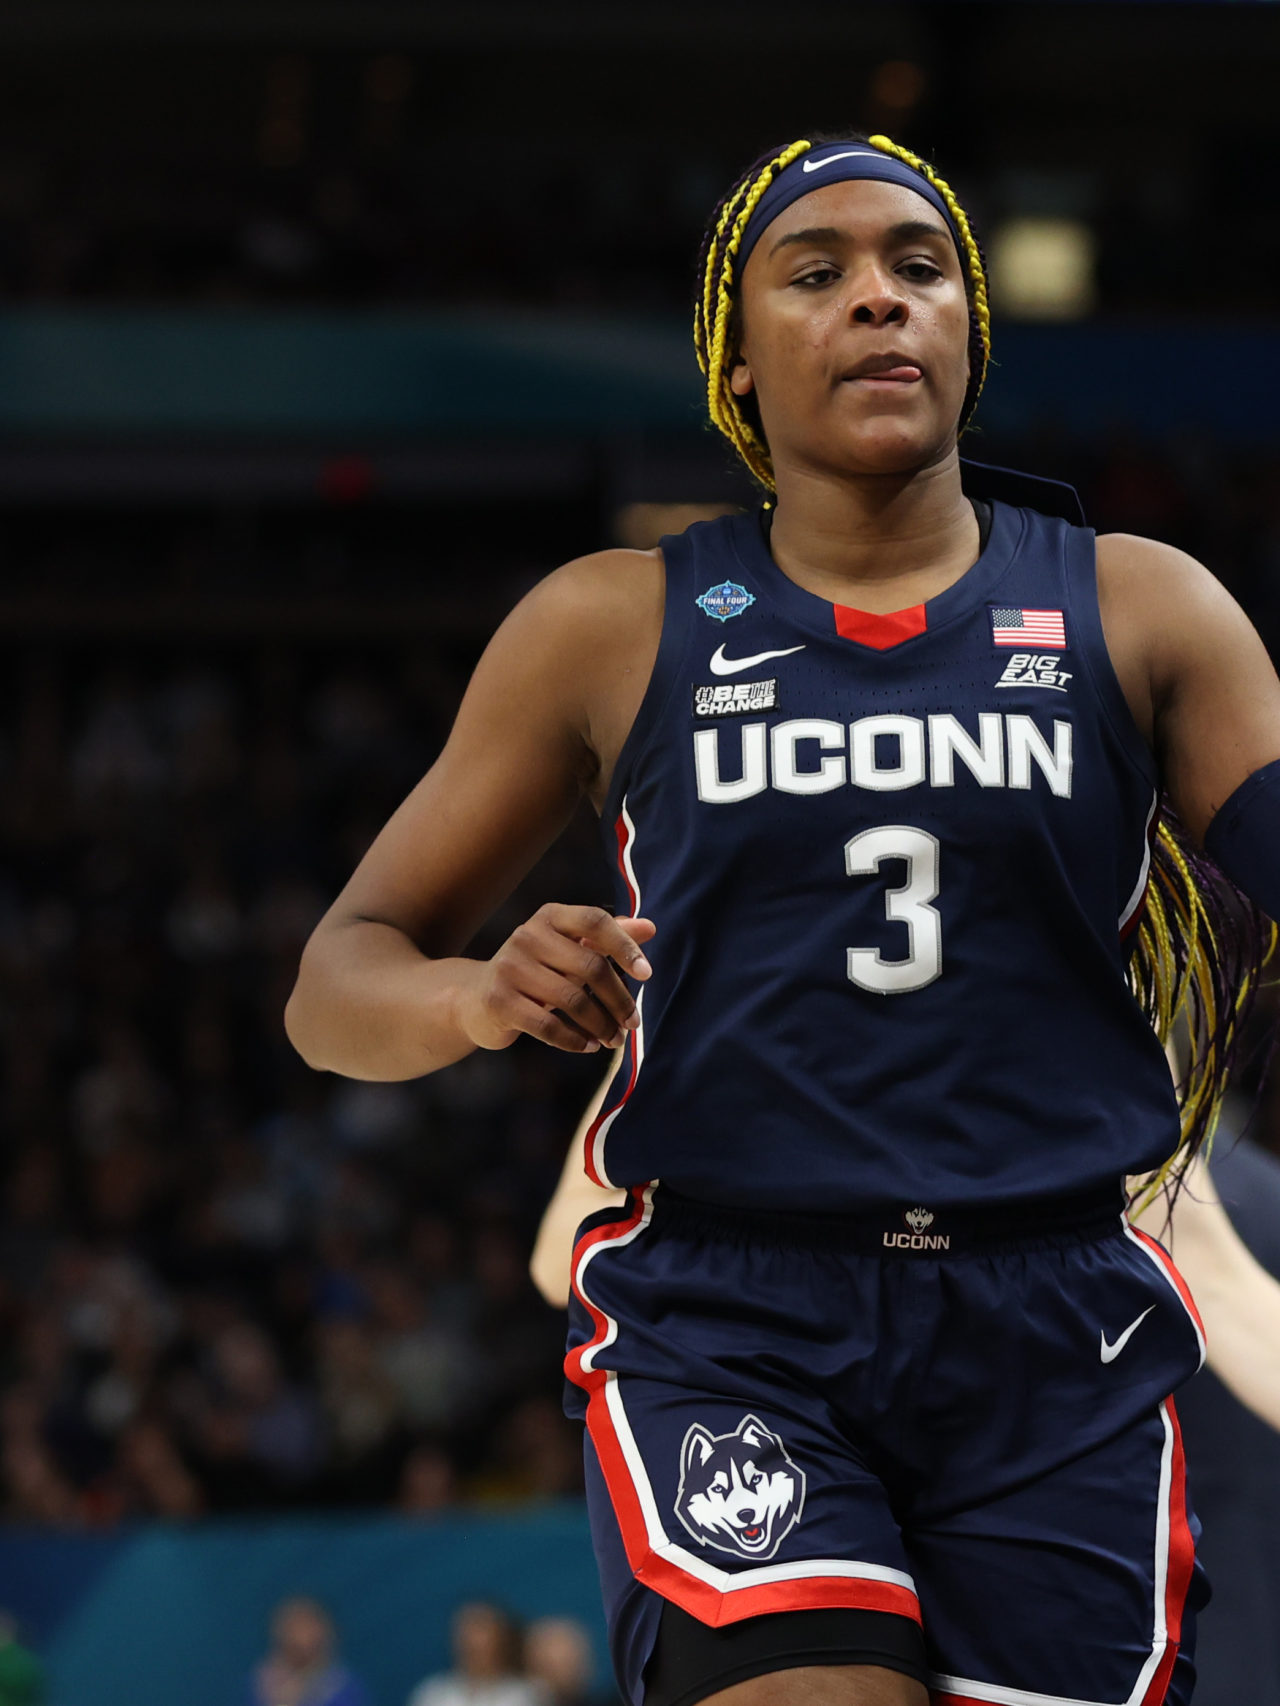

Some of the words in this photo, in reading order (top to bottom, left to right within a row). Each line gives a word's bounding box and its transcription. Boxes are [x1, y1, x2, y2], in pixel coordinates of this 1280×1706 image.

[703, 596, 724, 605] FINAL
[726, 596, 747, 605] FOUR
[1007, 653, 1061, 670] BIG
[999, 667, 1073, 686] EAST
[695, 695, 776, 716] CHANGE
[693, 712, 1073, 804] UCONN
[844, 825, 942, 994] 3
[882, 1232, 950, 1250] UCONN
